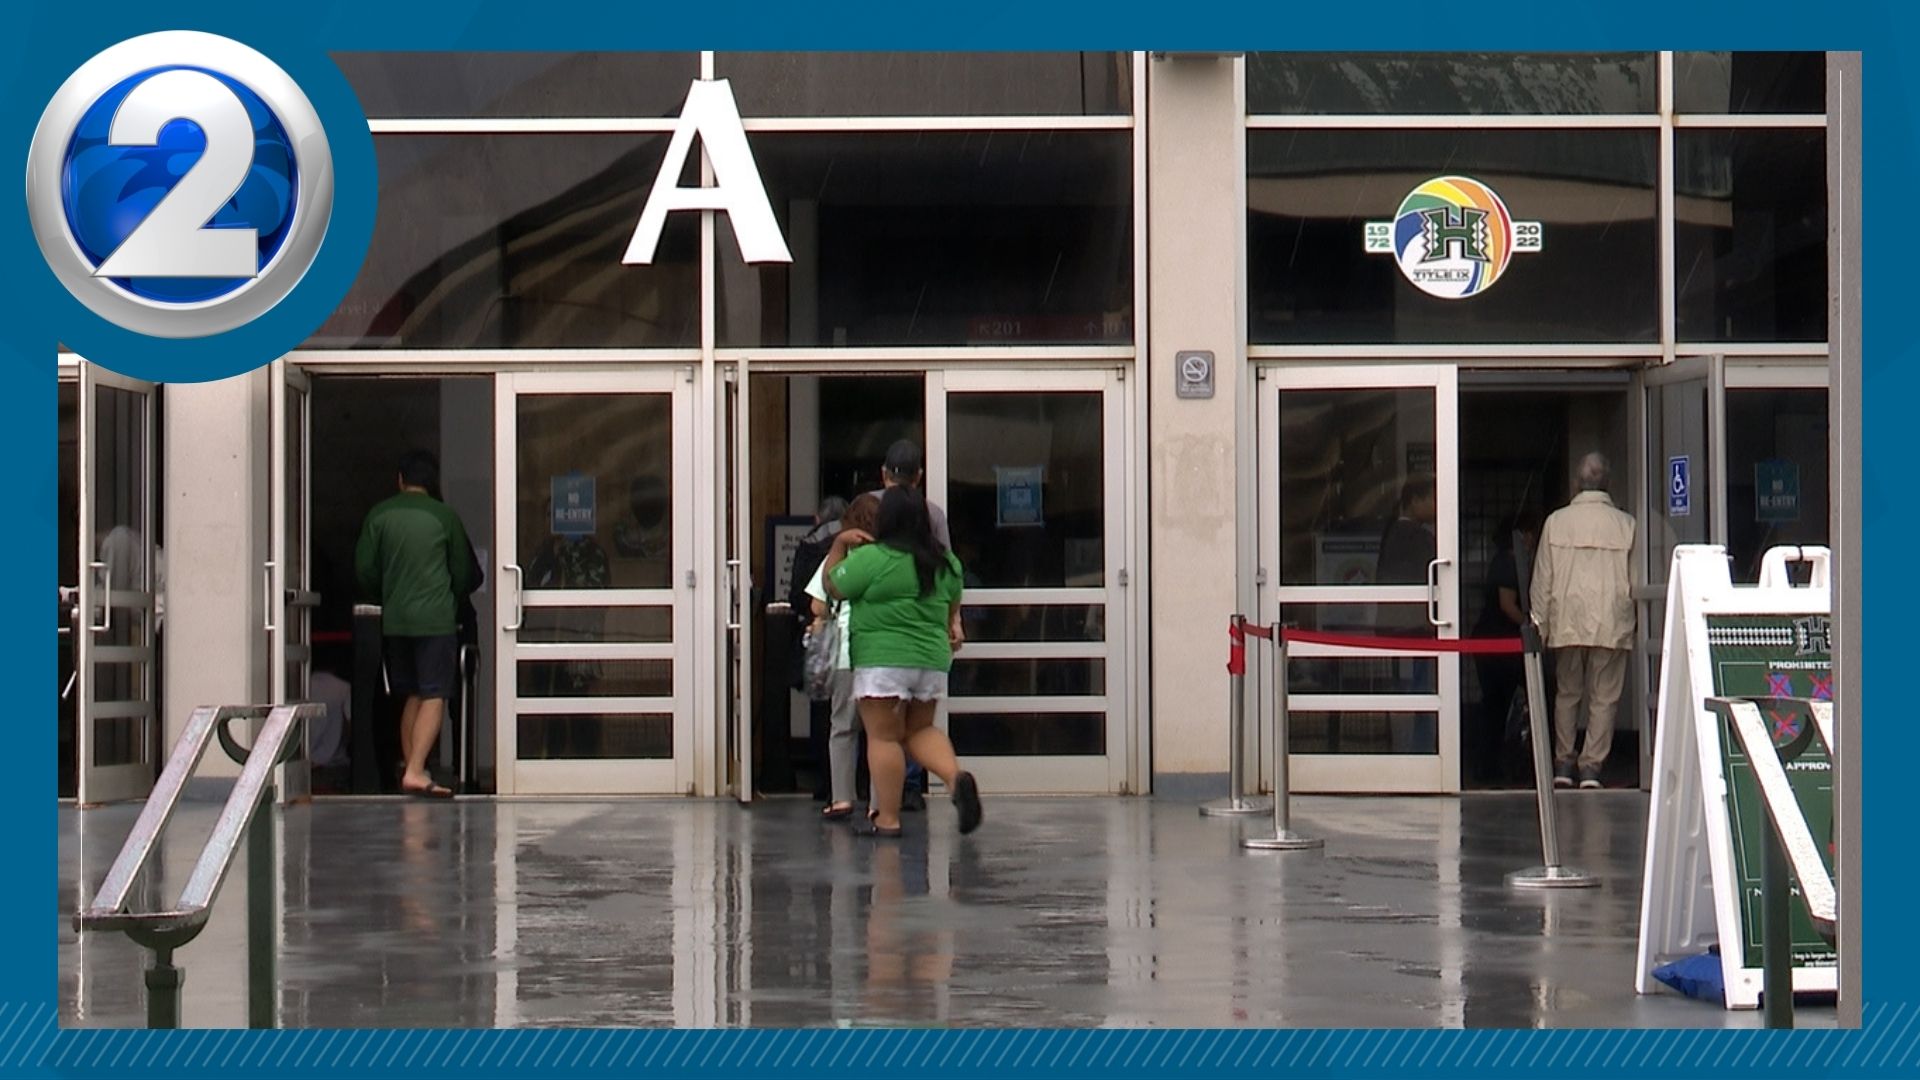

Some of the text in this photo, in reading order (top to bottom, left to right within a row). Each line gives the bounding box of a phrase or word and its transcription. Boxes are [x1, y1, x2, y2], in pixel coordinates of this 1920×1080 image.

[621, 78, 793, 265] A
[1368, 226, 1389, 236] 19
[1516, 225, 1538, 235] 20
[1368, 238, 1390, 248] 72
[1516, 237, 1538, 247] 22
[1413, 271, 1469, 279] TITLE IX
[992, 320, 1021, 336] 201
